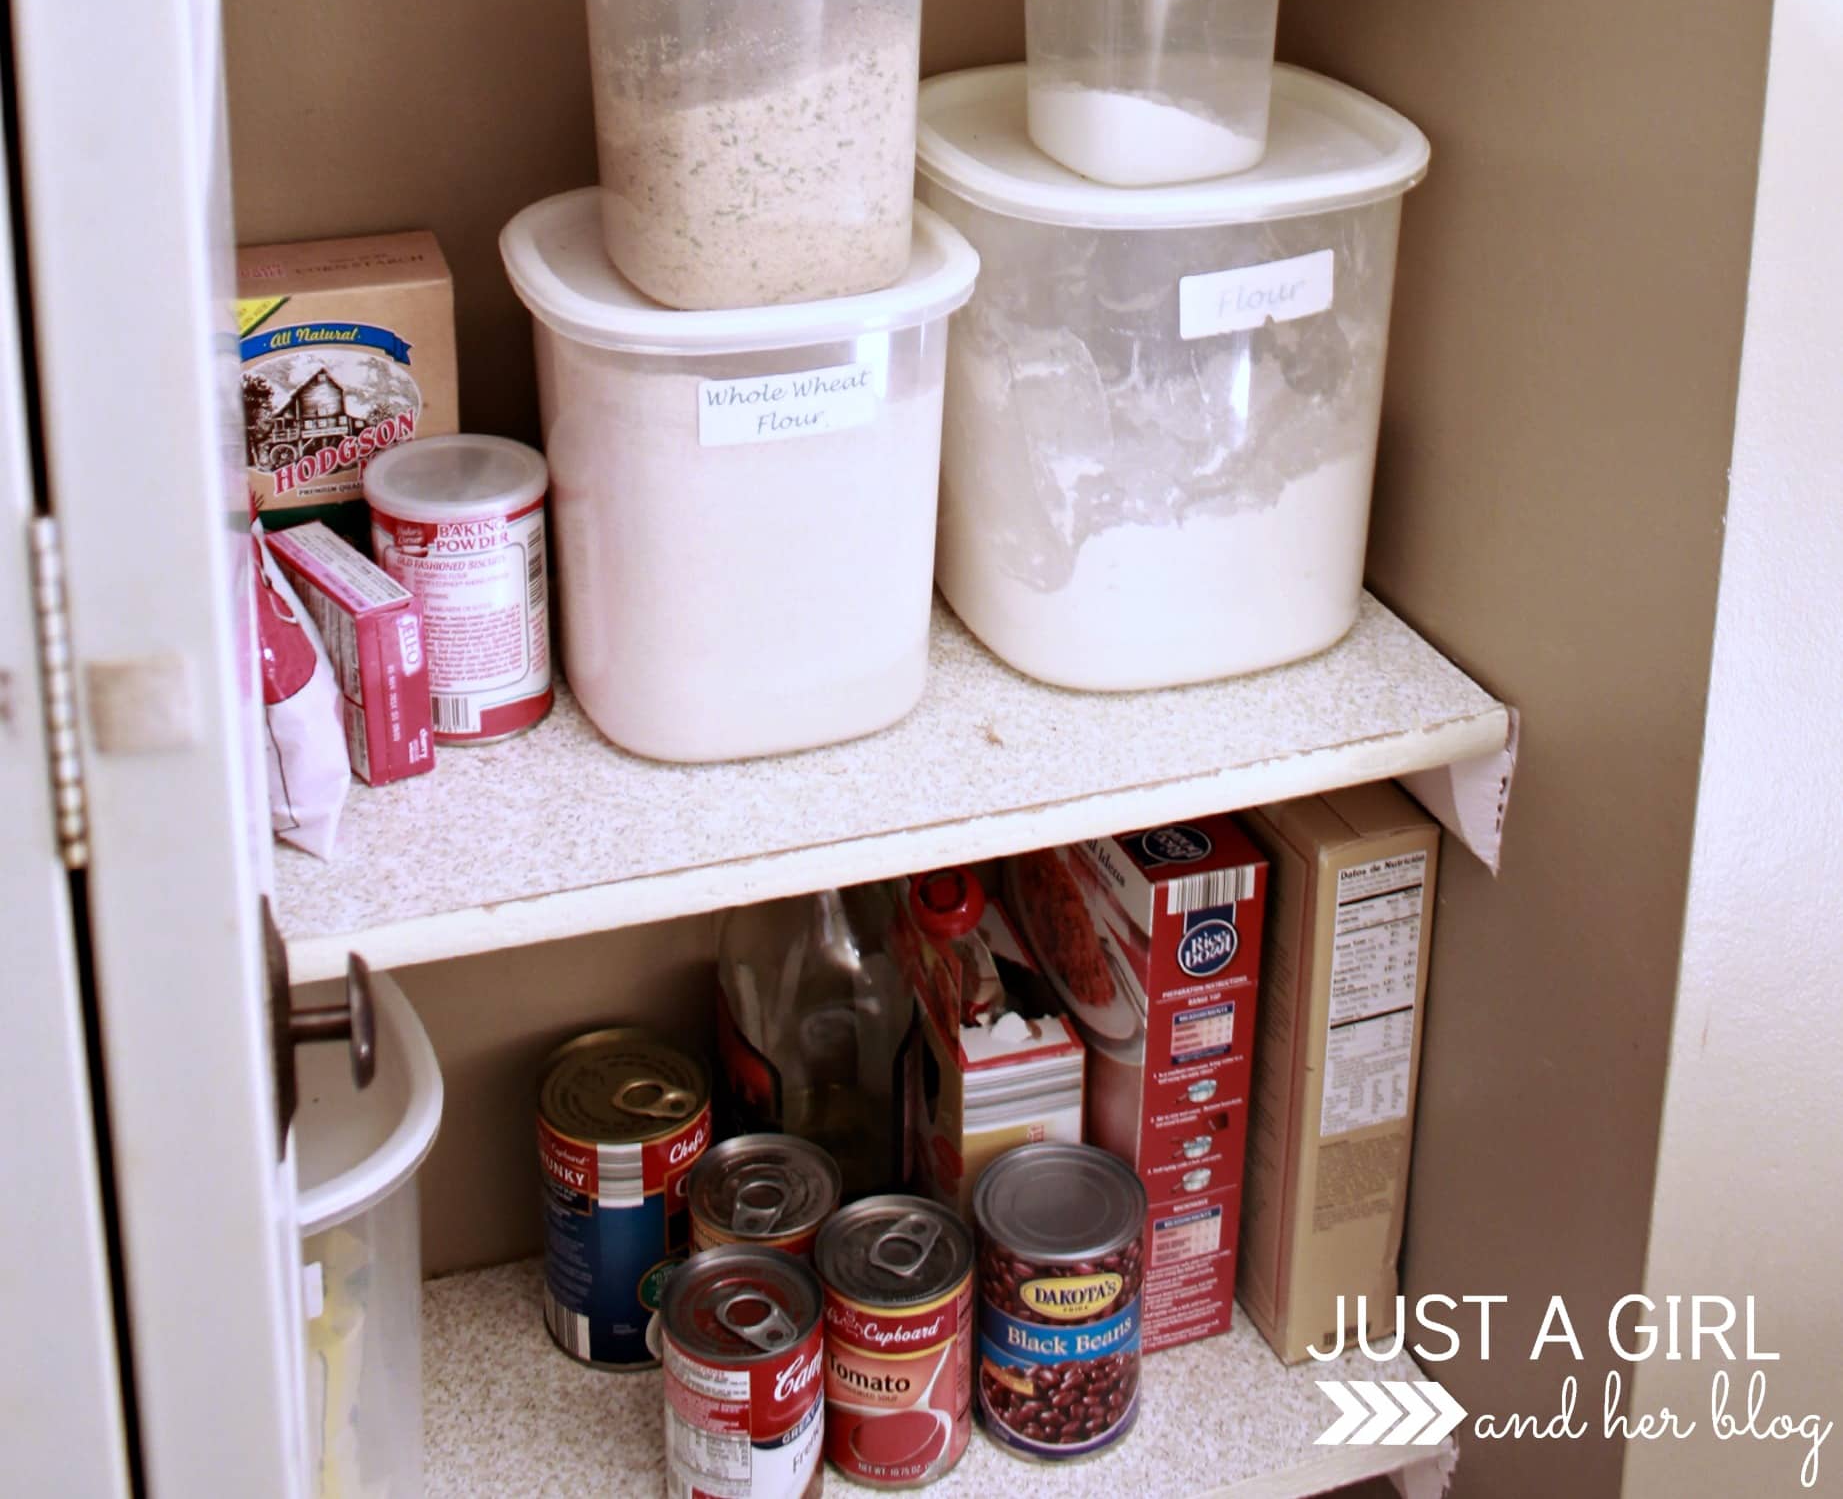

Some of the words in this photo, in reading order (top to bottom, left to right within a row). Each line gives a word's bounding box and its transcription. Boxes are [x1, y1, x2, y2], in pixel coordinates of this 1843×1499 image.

[1216, 279, 1306, 317] Flour
[270, 333, 291, 348] All
[296, 327, 358, 342] Natural
[706, 383, 787, 406] Whole
[792, 369, 871, 397] Wheat
[757, 410, 824, 435] Flour
[273, 409, 416, 495] HODGSON
[436, 532, 509, 553] POWDER
[439, 520, 504, 538] BAKING
[414, 558, 465, 571] FASHIONED
[1370, 865, 1381, 873] de
[544, 1153, 585, 1187] UNKY
[1034, 1279, 1117, 1306] DAKOTA'S
[863, 1316, 940, 1347] Cupboard
[1007, 1324, 1067, 1355] Black
[1075, 1315, 1132, 1351] Beans
[829, 1355, 911, 1392] Tomato
